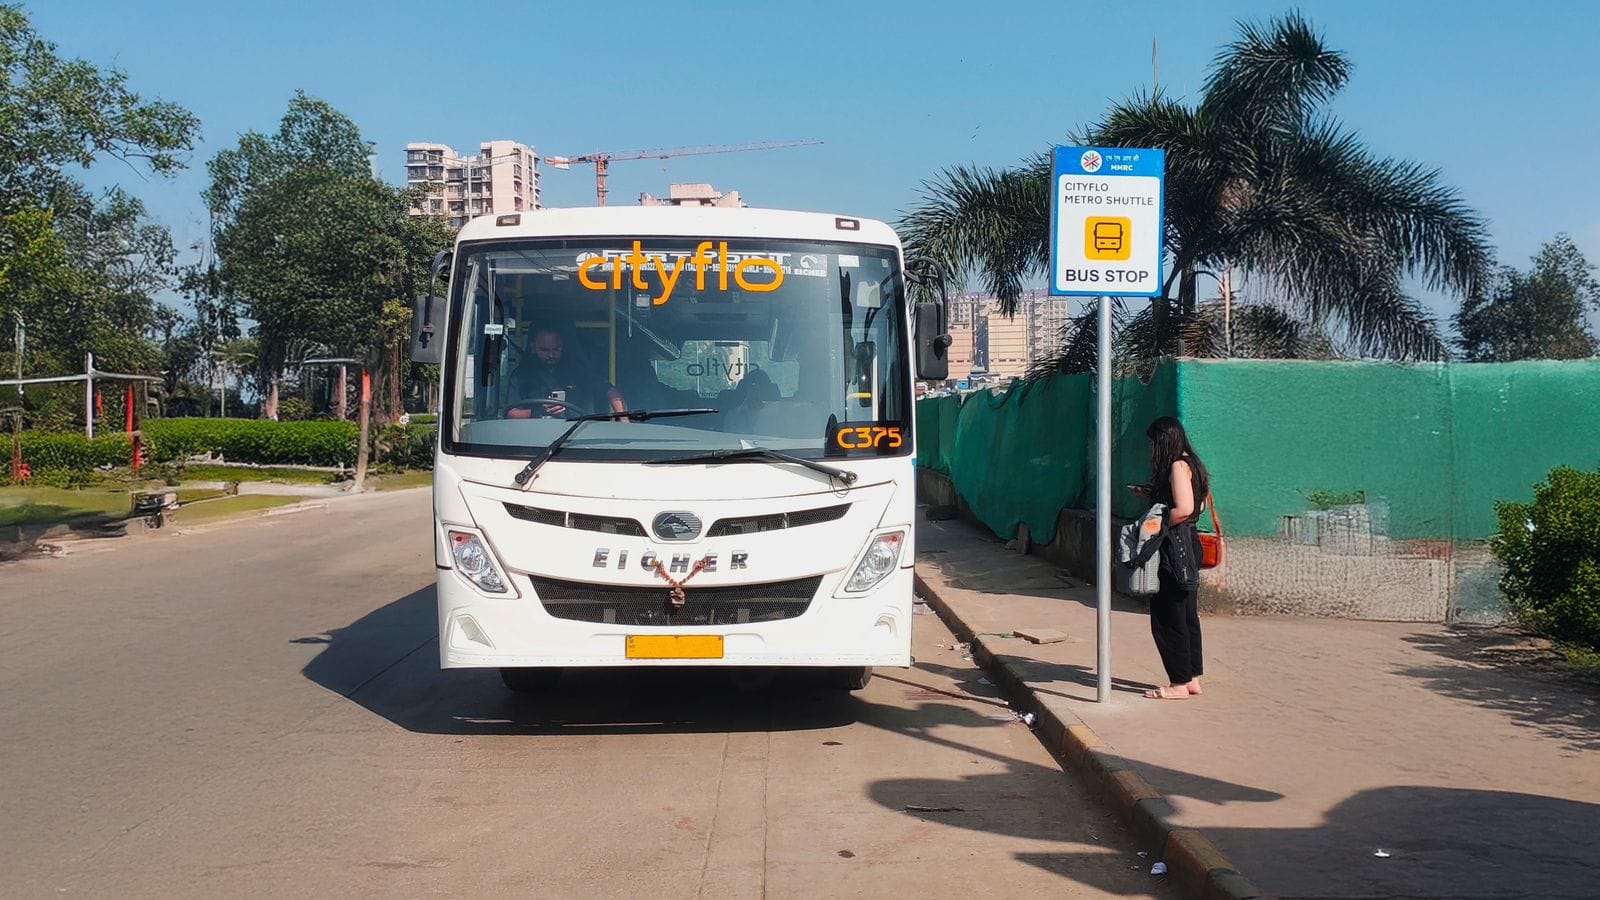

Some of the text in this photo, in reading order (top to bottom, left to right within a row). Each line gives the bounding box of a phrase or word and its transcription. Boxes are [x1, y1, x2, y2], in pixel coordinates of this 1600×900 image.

[1064, 182, 1109, 192] CITYFLO
[1064, 195, 1154, 206] METRO SHUTTLE
[578, 240, 785, 306] cityflo
[1065, 269, 1149, 283] BUS STOP
[837, 426, 903, 449] C375
[592, 547, 749, 574] EICHER
